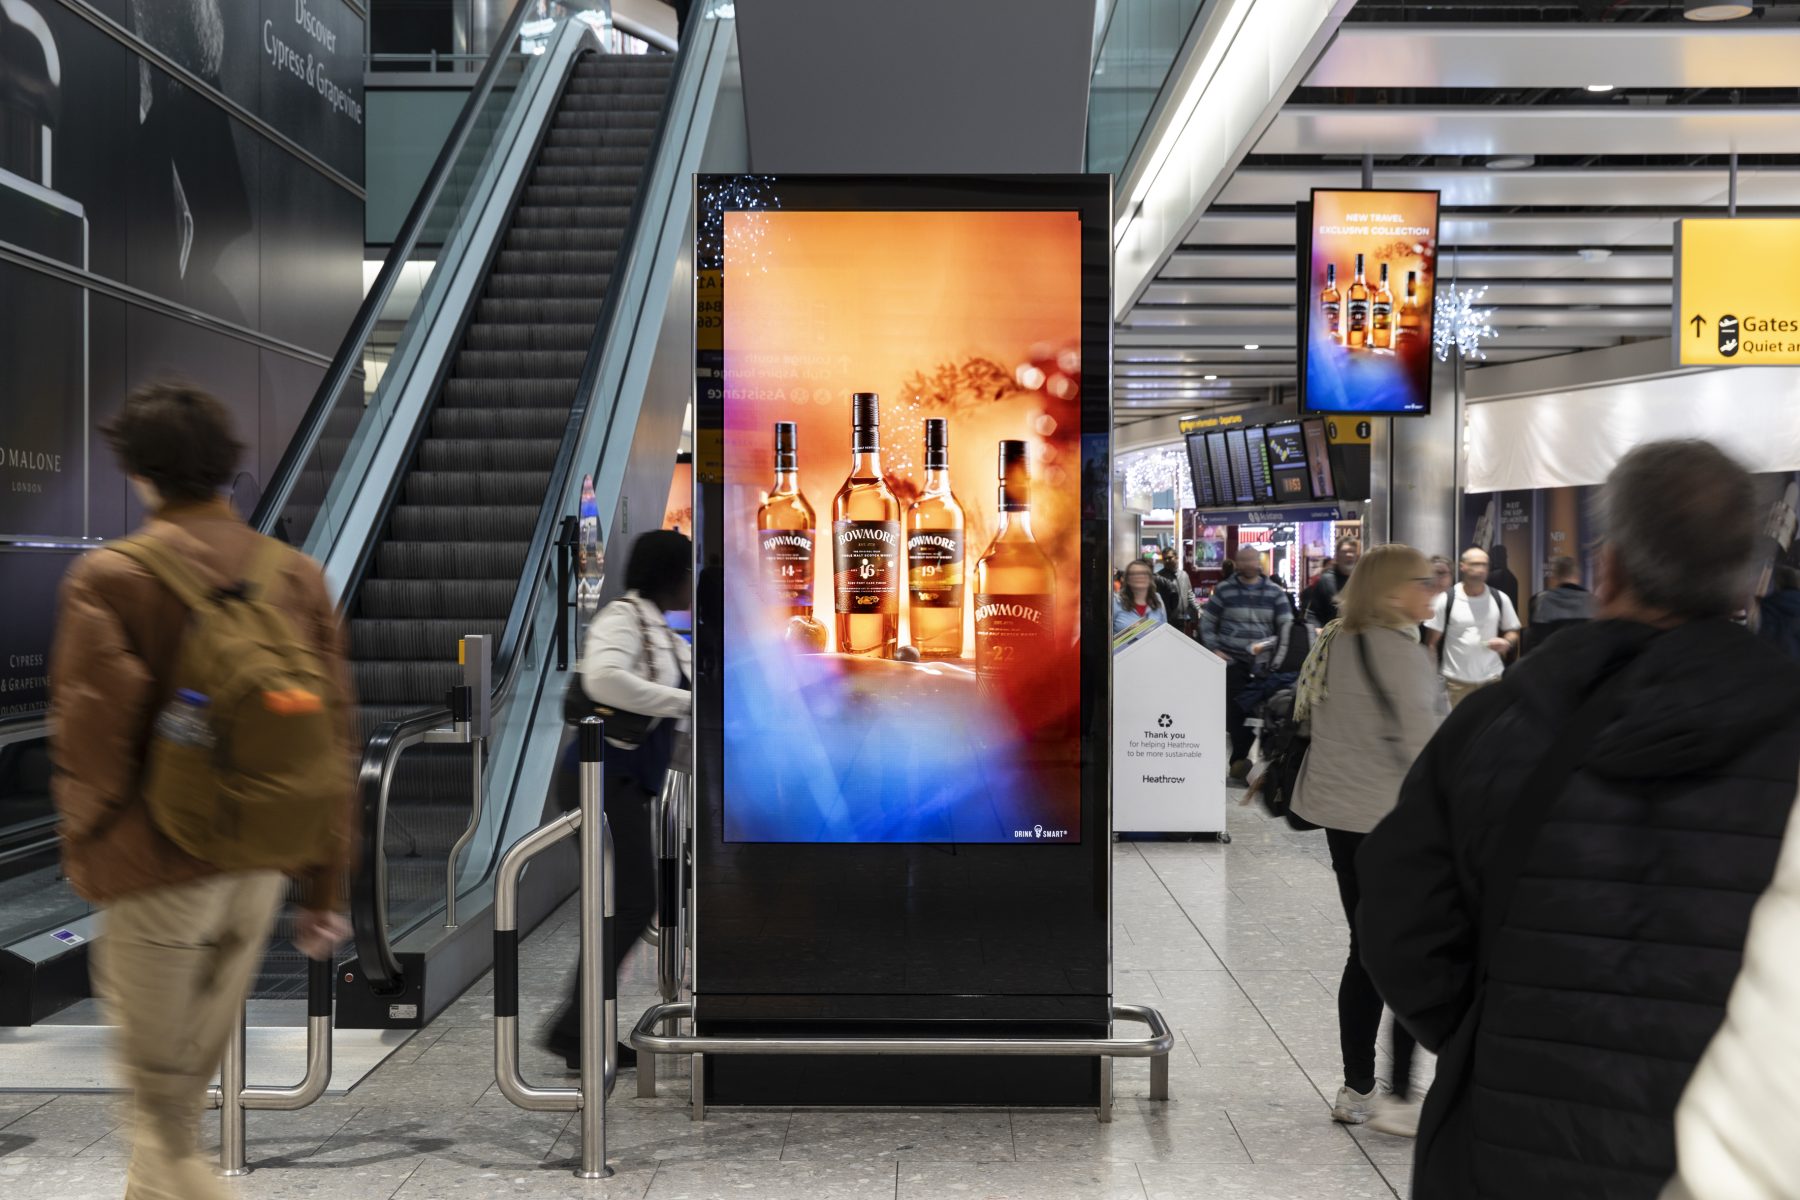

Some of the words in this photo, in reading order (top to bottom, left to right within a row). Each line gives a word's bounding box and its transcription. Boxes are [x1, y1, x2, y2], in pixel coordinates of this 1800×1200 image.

[295, 0, 336, 54] Discover
[263, 19, 304, 80] Cypress
[306, 53, 315, 88] &
[316, 62, 362, 125] Grapevine
[1346, 213, 1368, 223] NEW
[1370, 213, 1405, 223] TRAVEL
[1319, 225, 1369, 235] EXCLUSIVE
[1371, 226, 1430, 236] COLLECTION
[1743, 316, 1799, 332] Gates
[1743, 340, 1783, 353] Quiet
[9, 448, 61, 472] MALONE
[11, 481, 42, 493] LONDON
[763, 536, 812, 551] BOWMORE
[838, 529, 897, 547] BOWMORE
[908, 535, 956, 552] BOWMORE
[781, 564, 795, 577] 14
[859, 563, 875, 577] 16
[921, 565, 935, 577] 19
[975, 603, 1042, 624] BOWMORE
[993, 645, 1015, 661] 22
[9, 654, 43, 668] CYPRESS
[0, 678, 7, 692] &
[1144, 731, 1168, 739] Thank
[1129, 740, 1139, 748] for
[1141, 741, 1166, 749] helping
[1167, 741, 1201, 749] Heathrow
[1142, 774, 1186, 784] Heathrow
[1014, 830, 1033, 838] DRINK
